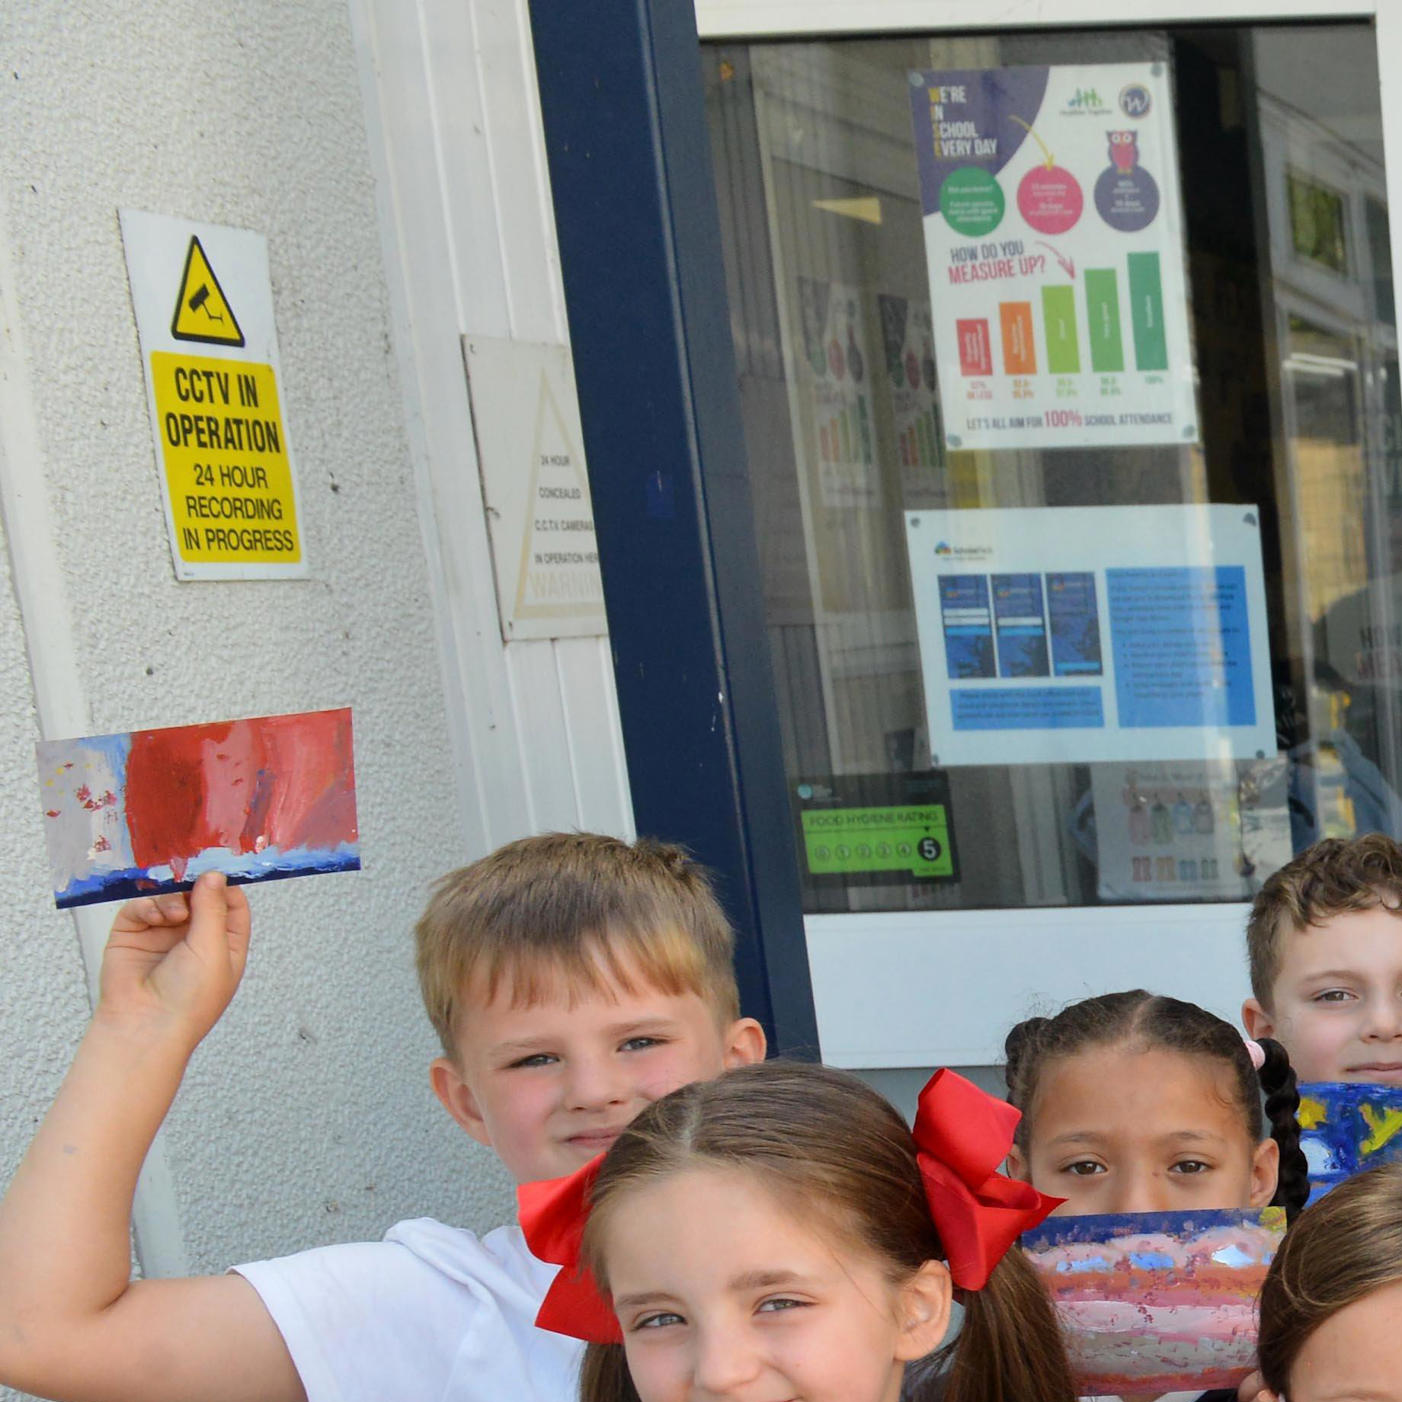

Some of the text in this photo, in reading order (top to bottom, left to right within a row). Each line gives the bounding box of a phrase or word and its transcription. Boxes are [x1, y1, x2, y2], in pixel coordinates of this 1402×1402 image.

[932, 121, 979, 139] SCHOOL
[934, 138, 998, 158] EVERY DAY
[950, 240, 1024, 264] HOW DO YOU
[948, 254, 1046, 284] MEASURE UP?
[174, 366, 260, 408] CCTV IN
[992, 416, 1007, 430] ALL
[1027, 415, 1043, 429] FOR
[1044, 409, 1083, 428] 100%
[1084, 414, 1117, 427] SCHOOL
[1118, 412, 1173, 426] ATTENDANCE
[164, 412, 281, 454] OPERATION
[193, 464, 269, 489] 24 HOUR
[539, 486, 582, 500] CONCEALED
[186, 496, 283, 521] RECORDING
[182, 528, 294, 553] IN PROGRESS
[545, 552, 583, 565] OPERATION
[809, 810, 939, 827] FOOD HYGIENE RATING
[922, 839, 938, 859] 5
